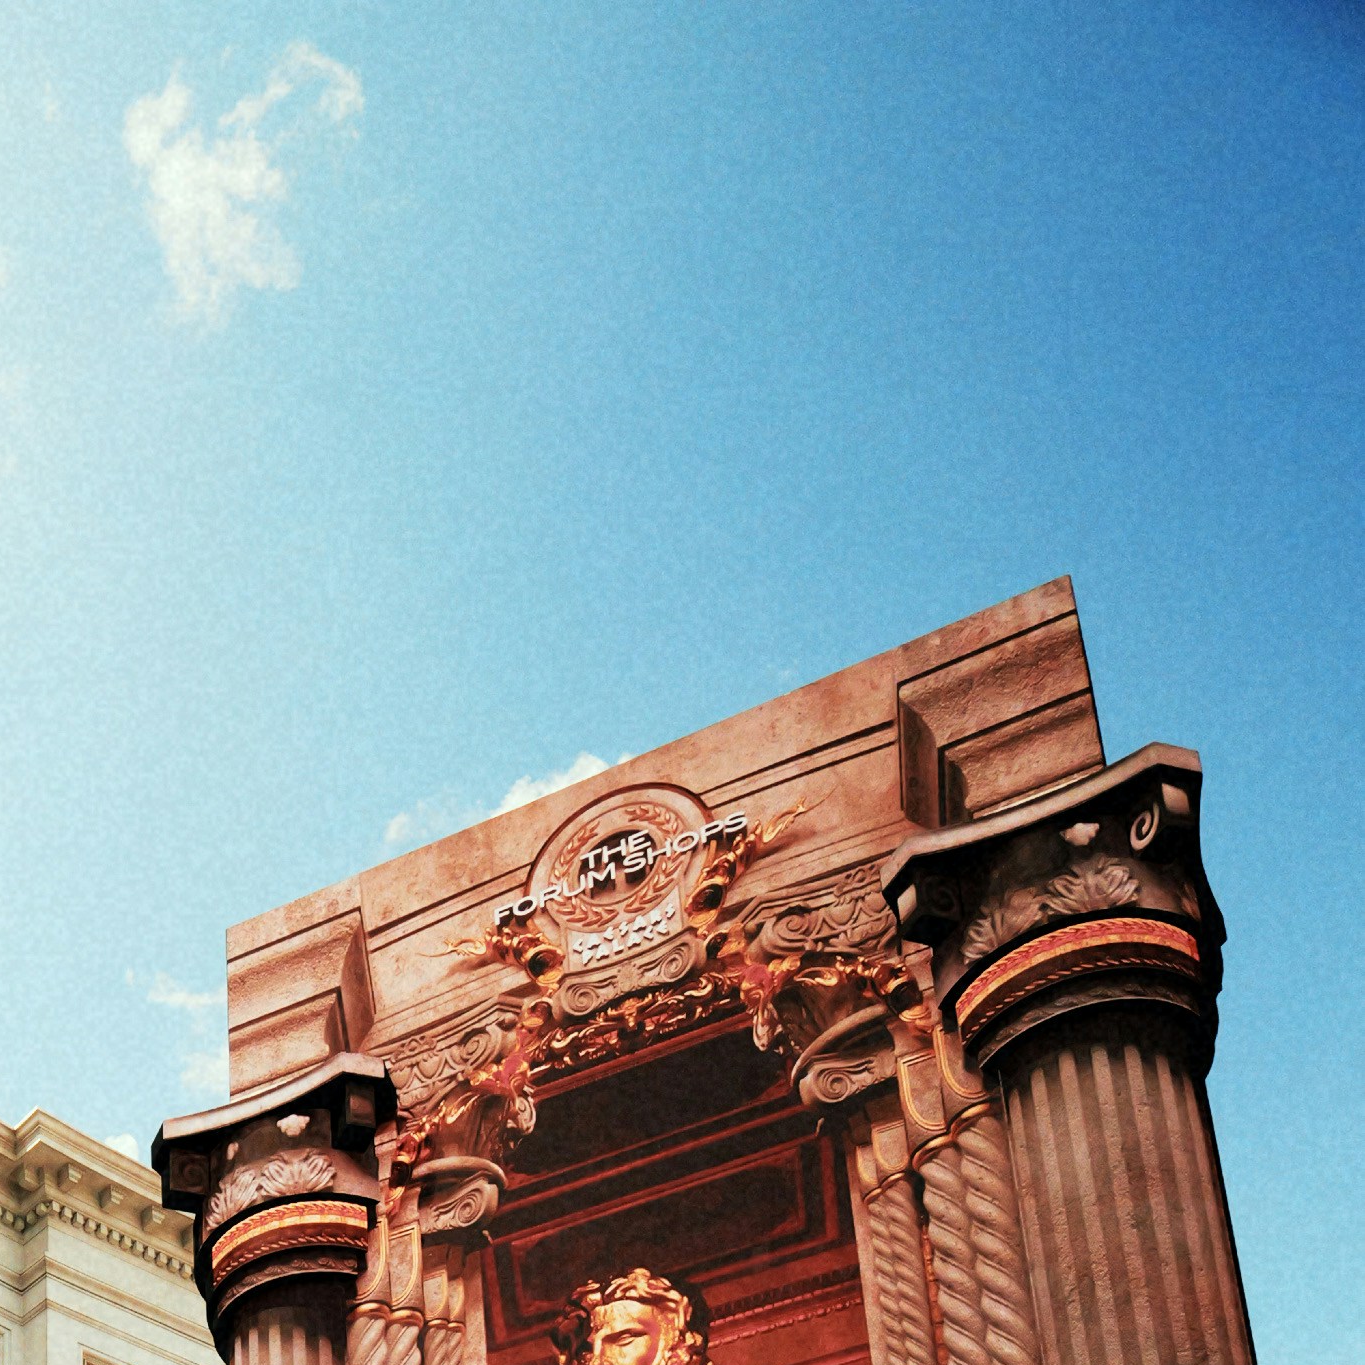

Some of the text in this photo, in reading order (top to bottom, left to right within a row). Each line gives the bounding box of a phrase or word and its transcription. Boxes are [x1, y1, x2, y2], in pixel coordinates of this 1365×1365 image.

[493, 810, 749, 926] FORUM SHOPS
[580, 830, 652, 869] THE
[573, 903, 676, 953] CAESARS
[582, 920, 669, 967] PALACE
